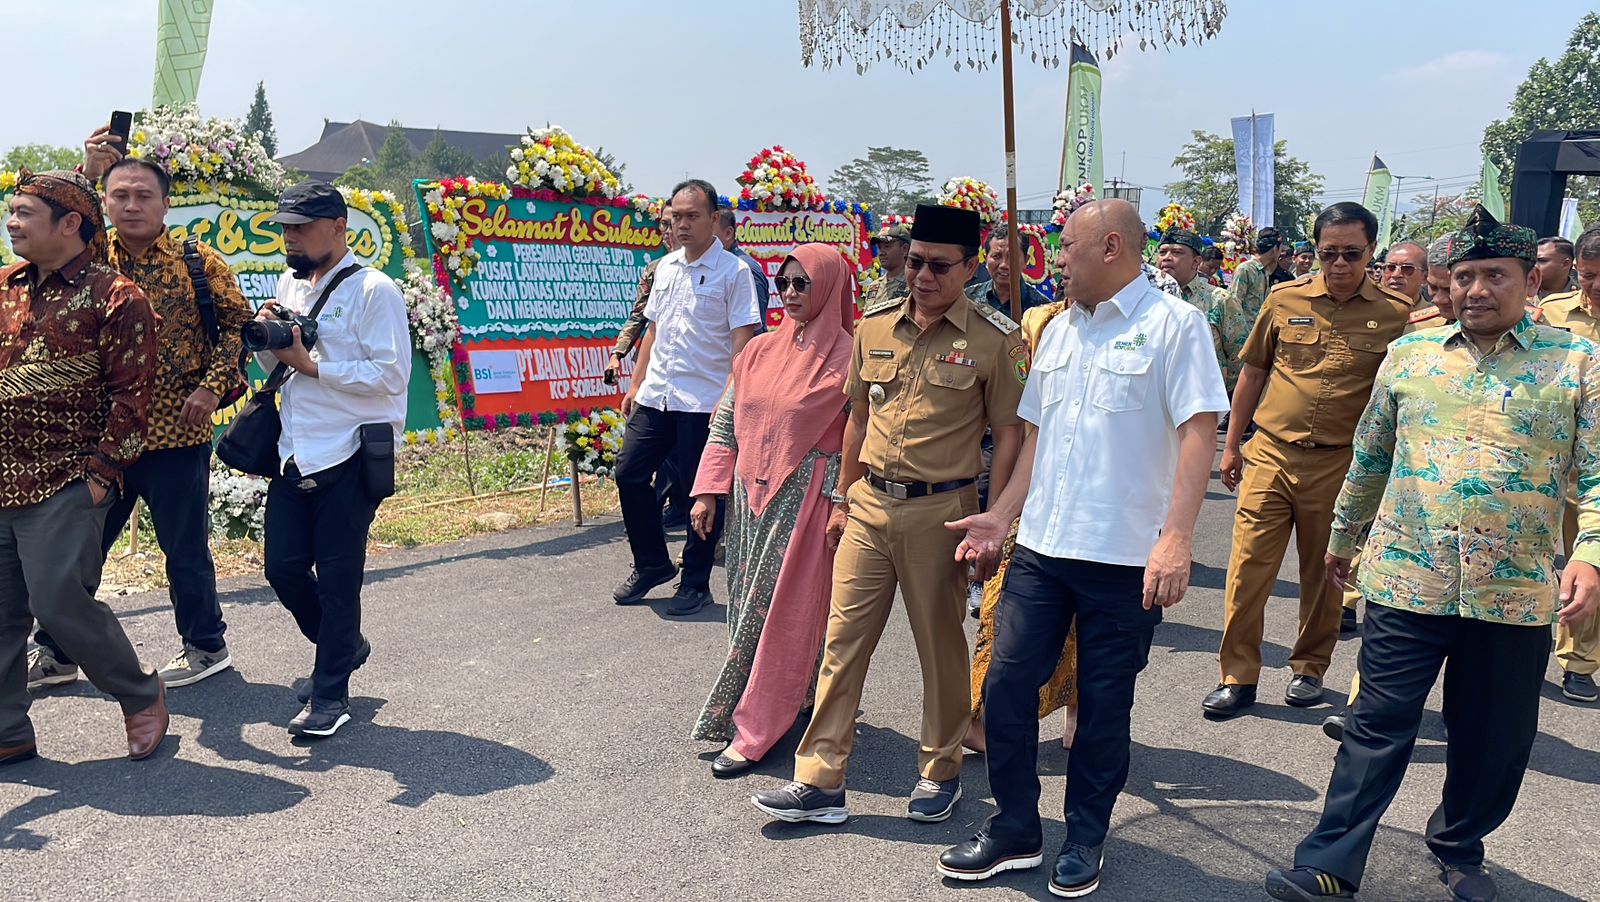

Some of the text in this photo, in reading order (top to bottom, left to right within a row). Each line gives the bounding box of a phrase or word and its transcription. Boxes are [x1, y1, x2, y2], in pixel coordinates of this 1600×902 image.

[1373, 186, 1386, 213] UKM
[216, 209, 247, 254] &
[462, 198, 662, 247] Selamat & Sukses
[735, 215, 851, 243] elamat & Sukses
[512, 243, 635, 266] PERESMIAN GEDUNG UPTD
[476, 261, 513, 281] PUSAT
[513, 262, 566, 281] LAYANAN
[564, 263, 601, 282] USAHA
[598, 264, 637, 283] TERPADU
[470, 281, 520, 301] KUMKM
[518, 281, 554, 301] DINAS
[552, 281, 601, 301] KOPERASI
[600, 282, 622, 301] DAN
[485, 300, 515, 319] DAN
[514, 300, 575, 319] MENENGAH
[573, 300, 628, 319] KABUPATEN
[474, 368, 492, 380] BSI
[549, 380, 571, 400] KCP
